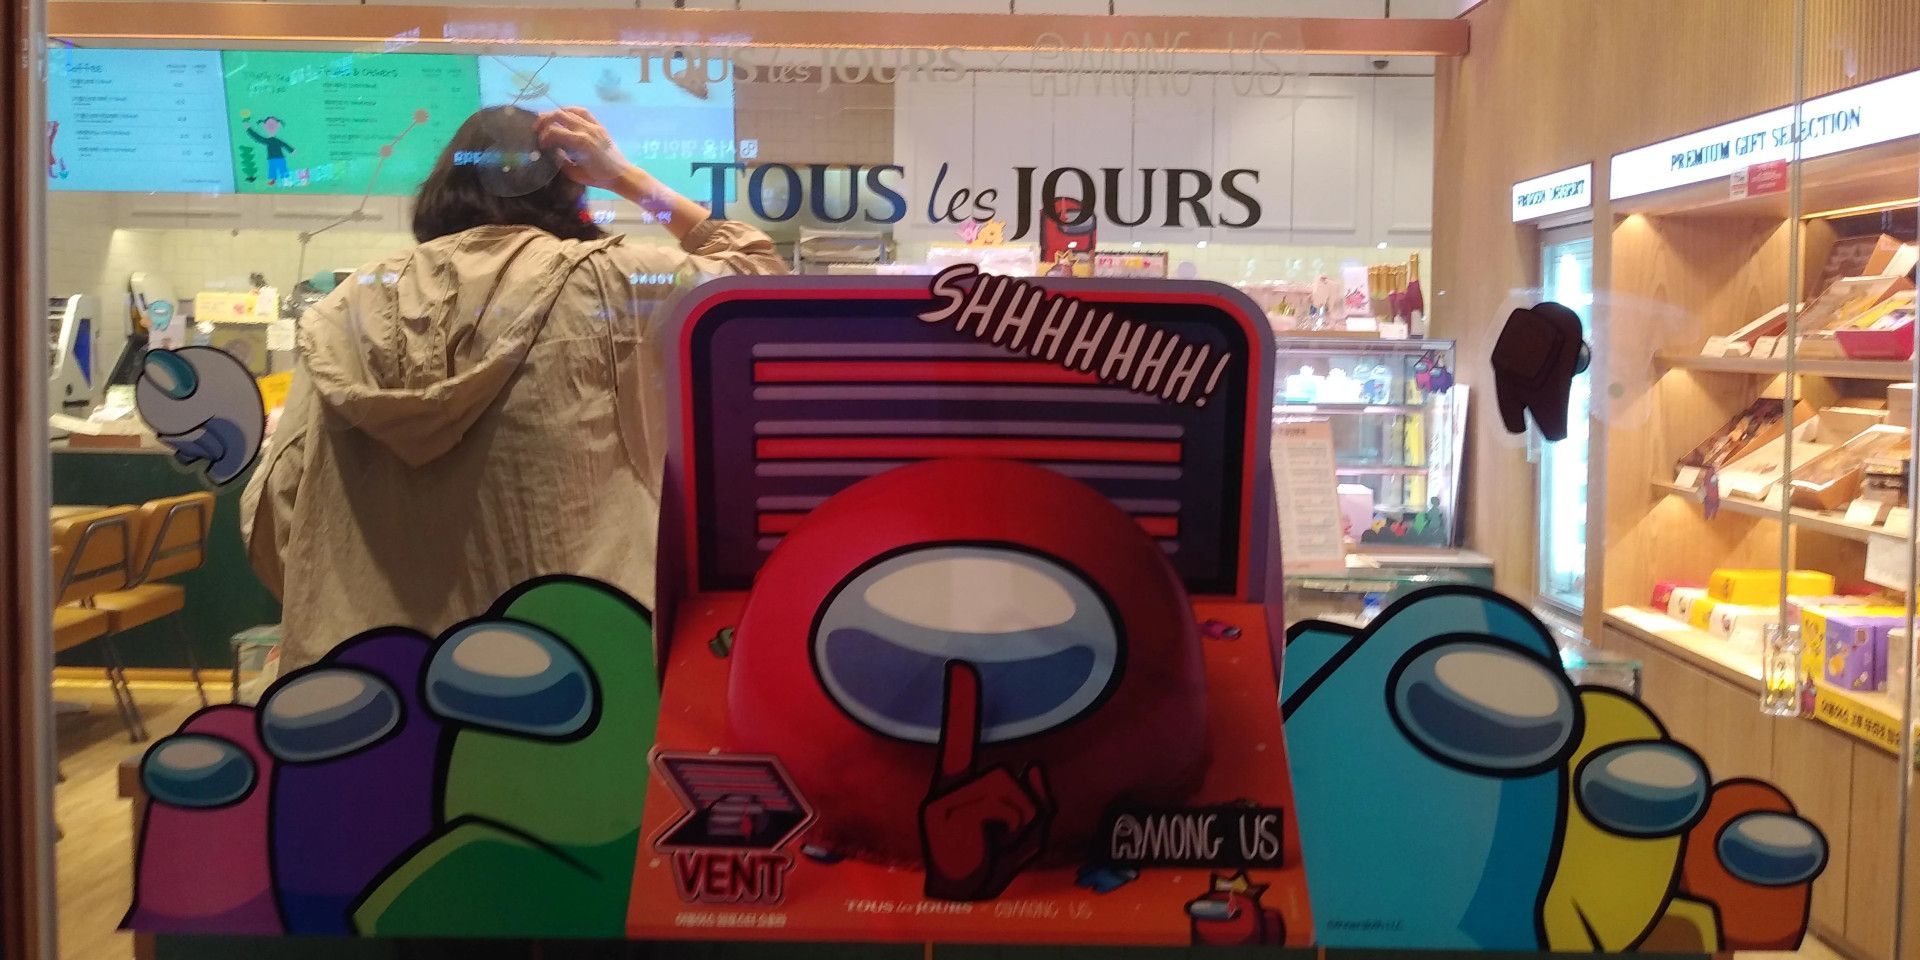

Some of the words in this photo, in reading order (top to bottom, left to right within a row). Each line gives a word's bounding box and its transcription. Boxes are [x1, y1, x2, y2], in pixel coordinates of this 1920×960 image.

[629, 47, 758, 84] TOUS
[766, 49, 811, 84] les
[815, 47, 968, 92] JOURS
[1226, 31, 1285, 98] US
[1670, 140, 1731, 172] PREMIUM
[1735, 131, 1768, 156] GIFT
[1772, 109, 1861, 148] SELECTION
[690, 161, 908, 224] TOUS
[926, 161, 997, 225] les
[1010, 164, 1263, 241] JOURS
[917, 262, 1232, 408] SHHHHHHH!
[1111, 813, 1225, 861] AMONG
[1238, 813, 1280, 861] US
[674, 851, 790, 902] VENT
